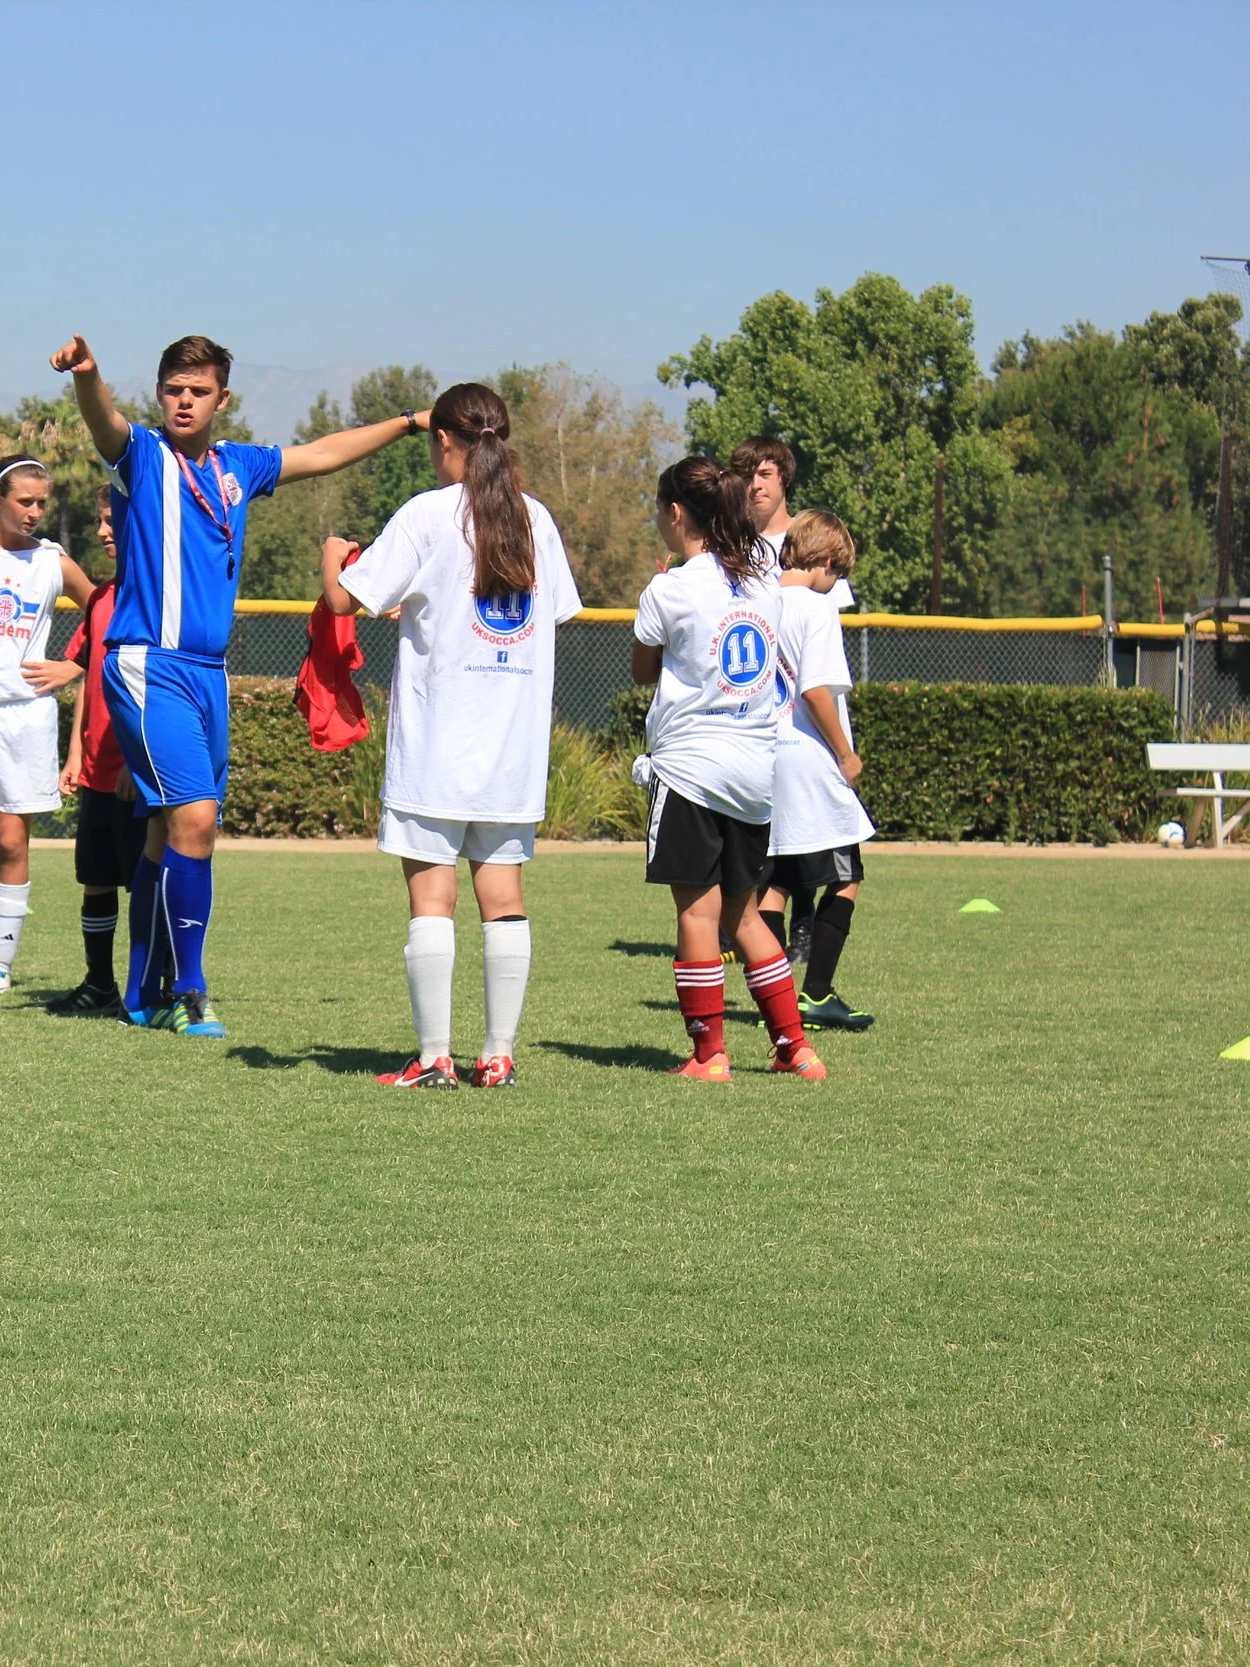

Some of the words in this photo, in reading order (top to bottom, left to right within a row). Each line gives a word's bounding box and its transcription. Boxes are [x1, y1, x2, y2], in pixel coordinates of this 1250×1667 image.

[471, 621, 535, 646] UKSOCCA.COM
[709, 632, 721, 656] U.K.
[718, 610, 777, 648] INTERNATIONAL
[727, 630, 759, 676] 11
[717, 669, 773, 697] UKSOCCA.COM
